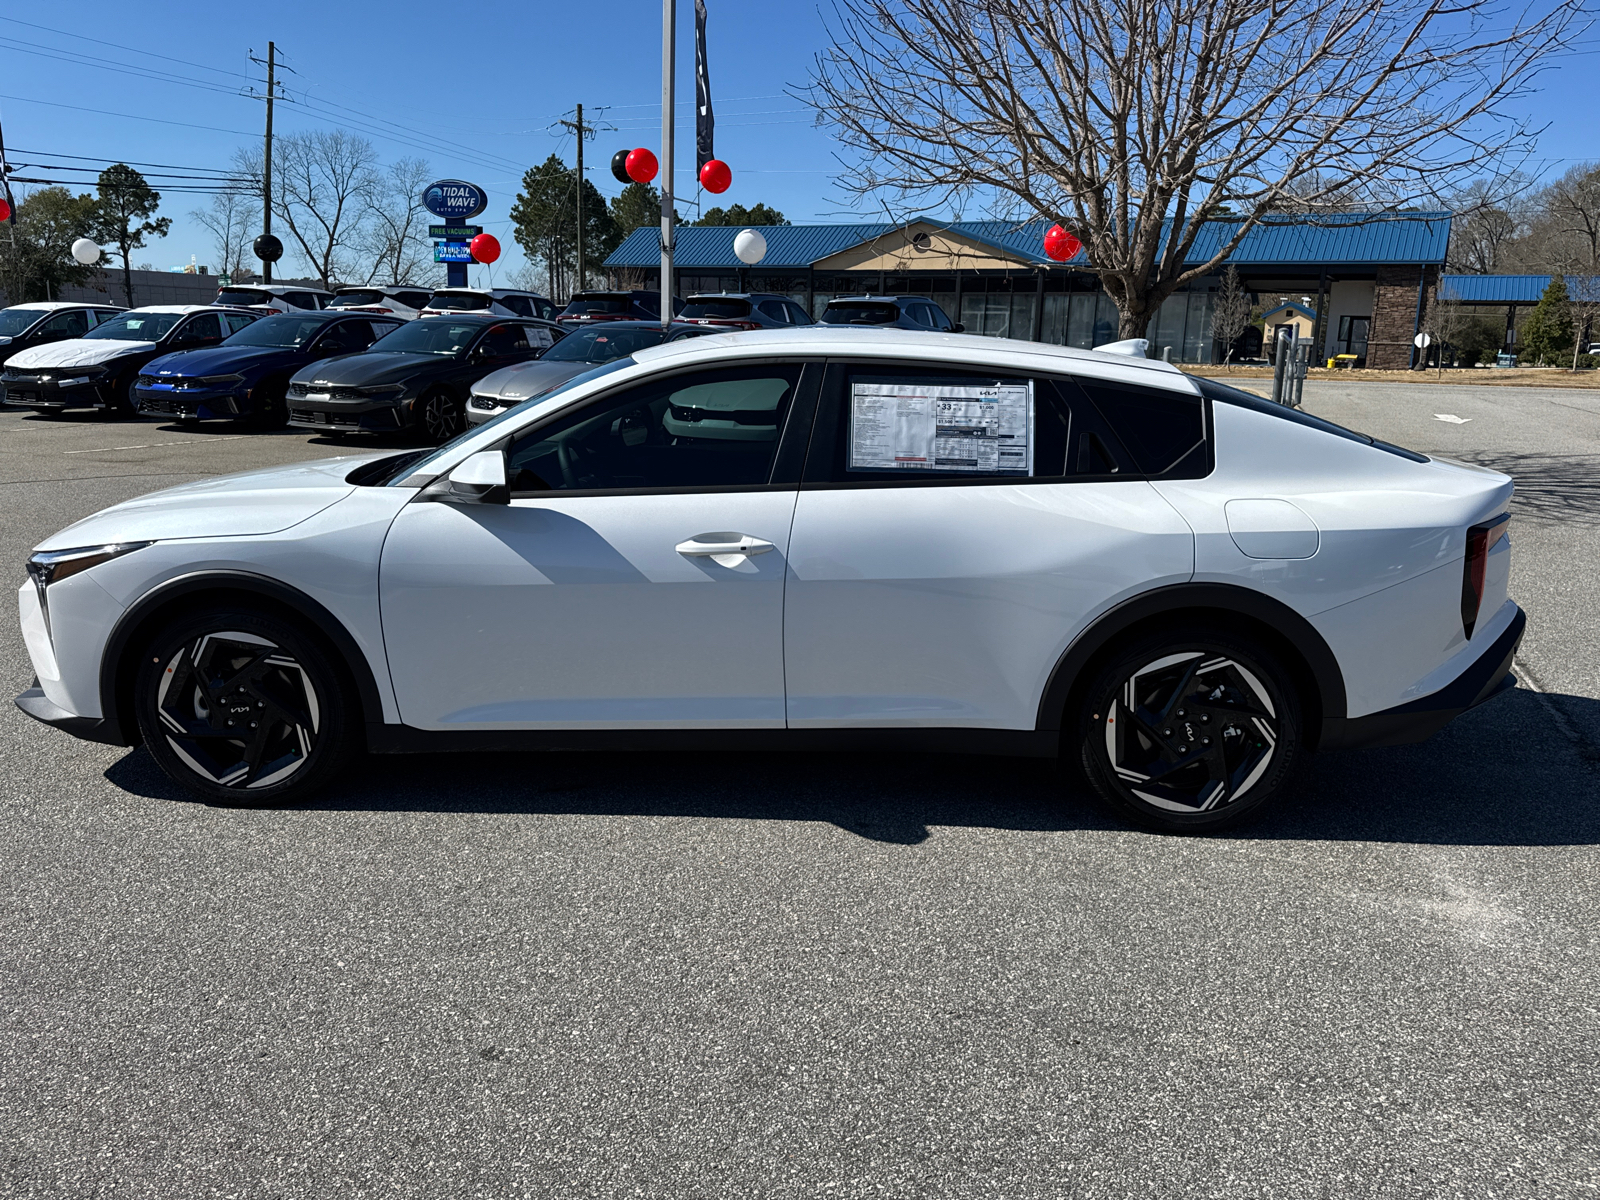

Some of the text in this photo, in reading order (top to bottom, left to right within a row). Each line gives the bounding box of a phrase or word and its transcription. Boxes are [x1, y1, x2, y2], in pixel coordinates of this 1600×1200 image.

[442, 187, 470, 197] TIDAL
[447, 197, 476, 207] WAVE
[941, 403, 952, 411] 33
[1270, 739, 1295, 788] KUMHO
